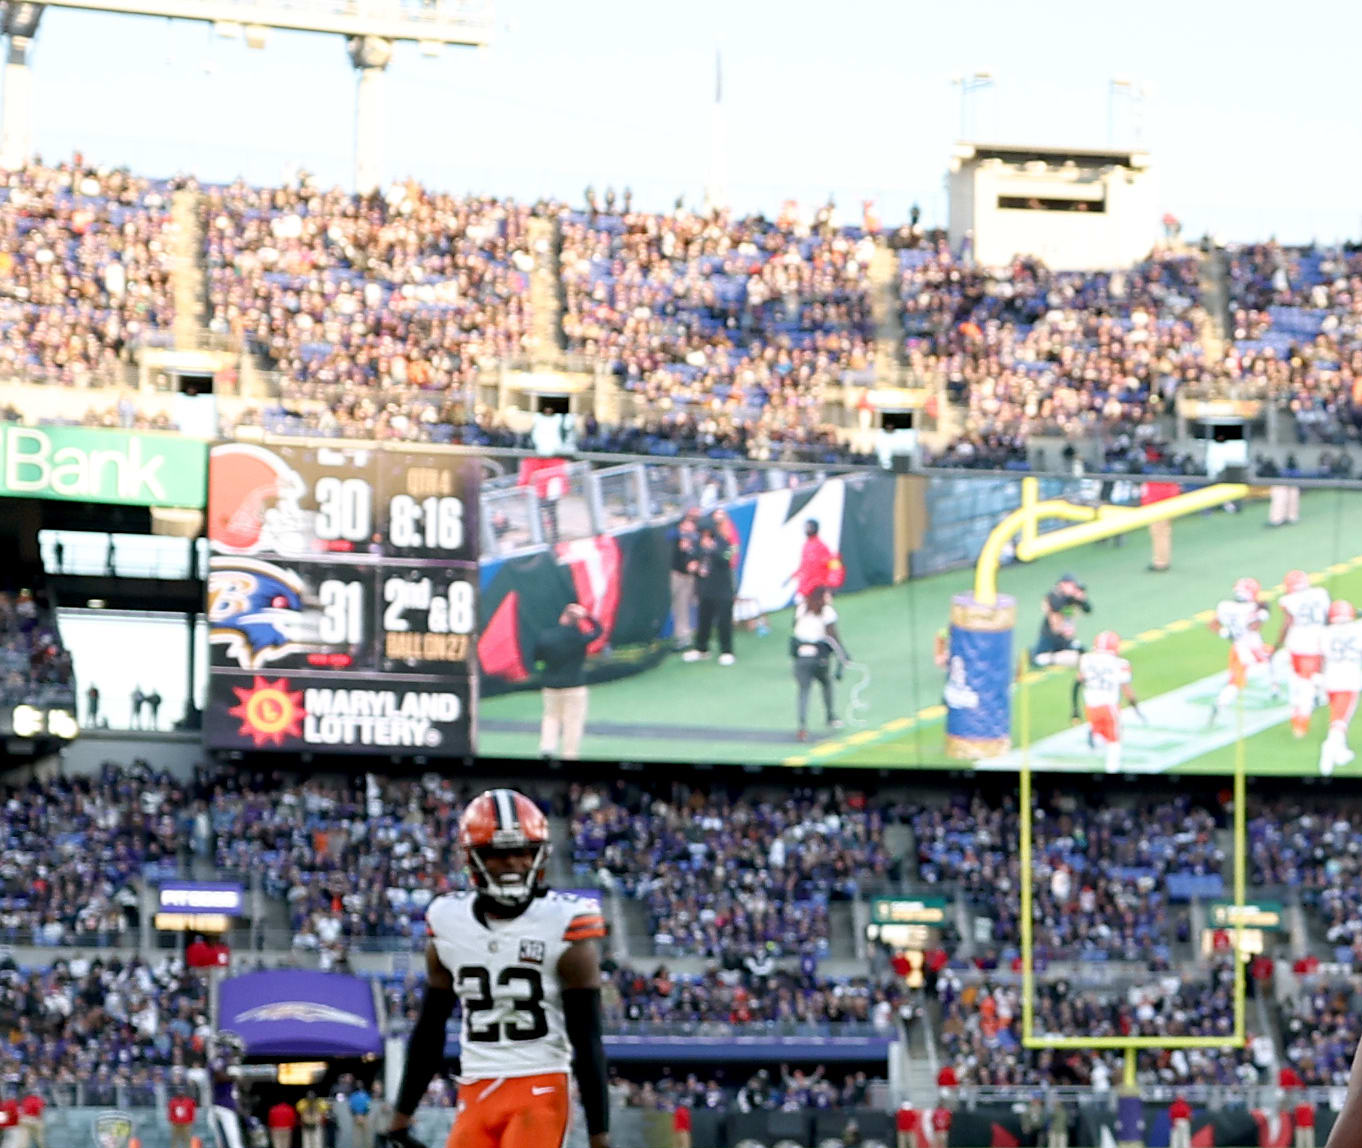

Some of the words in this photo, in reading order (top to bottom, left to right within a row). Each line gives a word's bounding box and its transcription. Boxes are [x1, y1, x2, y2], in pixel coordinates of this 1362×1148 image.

[5, 426, 165, 499] Bank
[315, 477, 370, 541] 30
[390, 495, 463, 549] 8:16
[318, 579, 363, 644] 31
[304, 688, 461, 721] MARYLAND
[304, 714, 424, 745] LOTTERY
[458, 966, 549, 1042] 23
